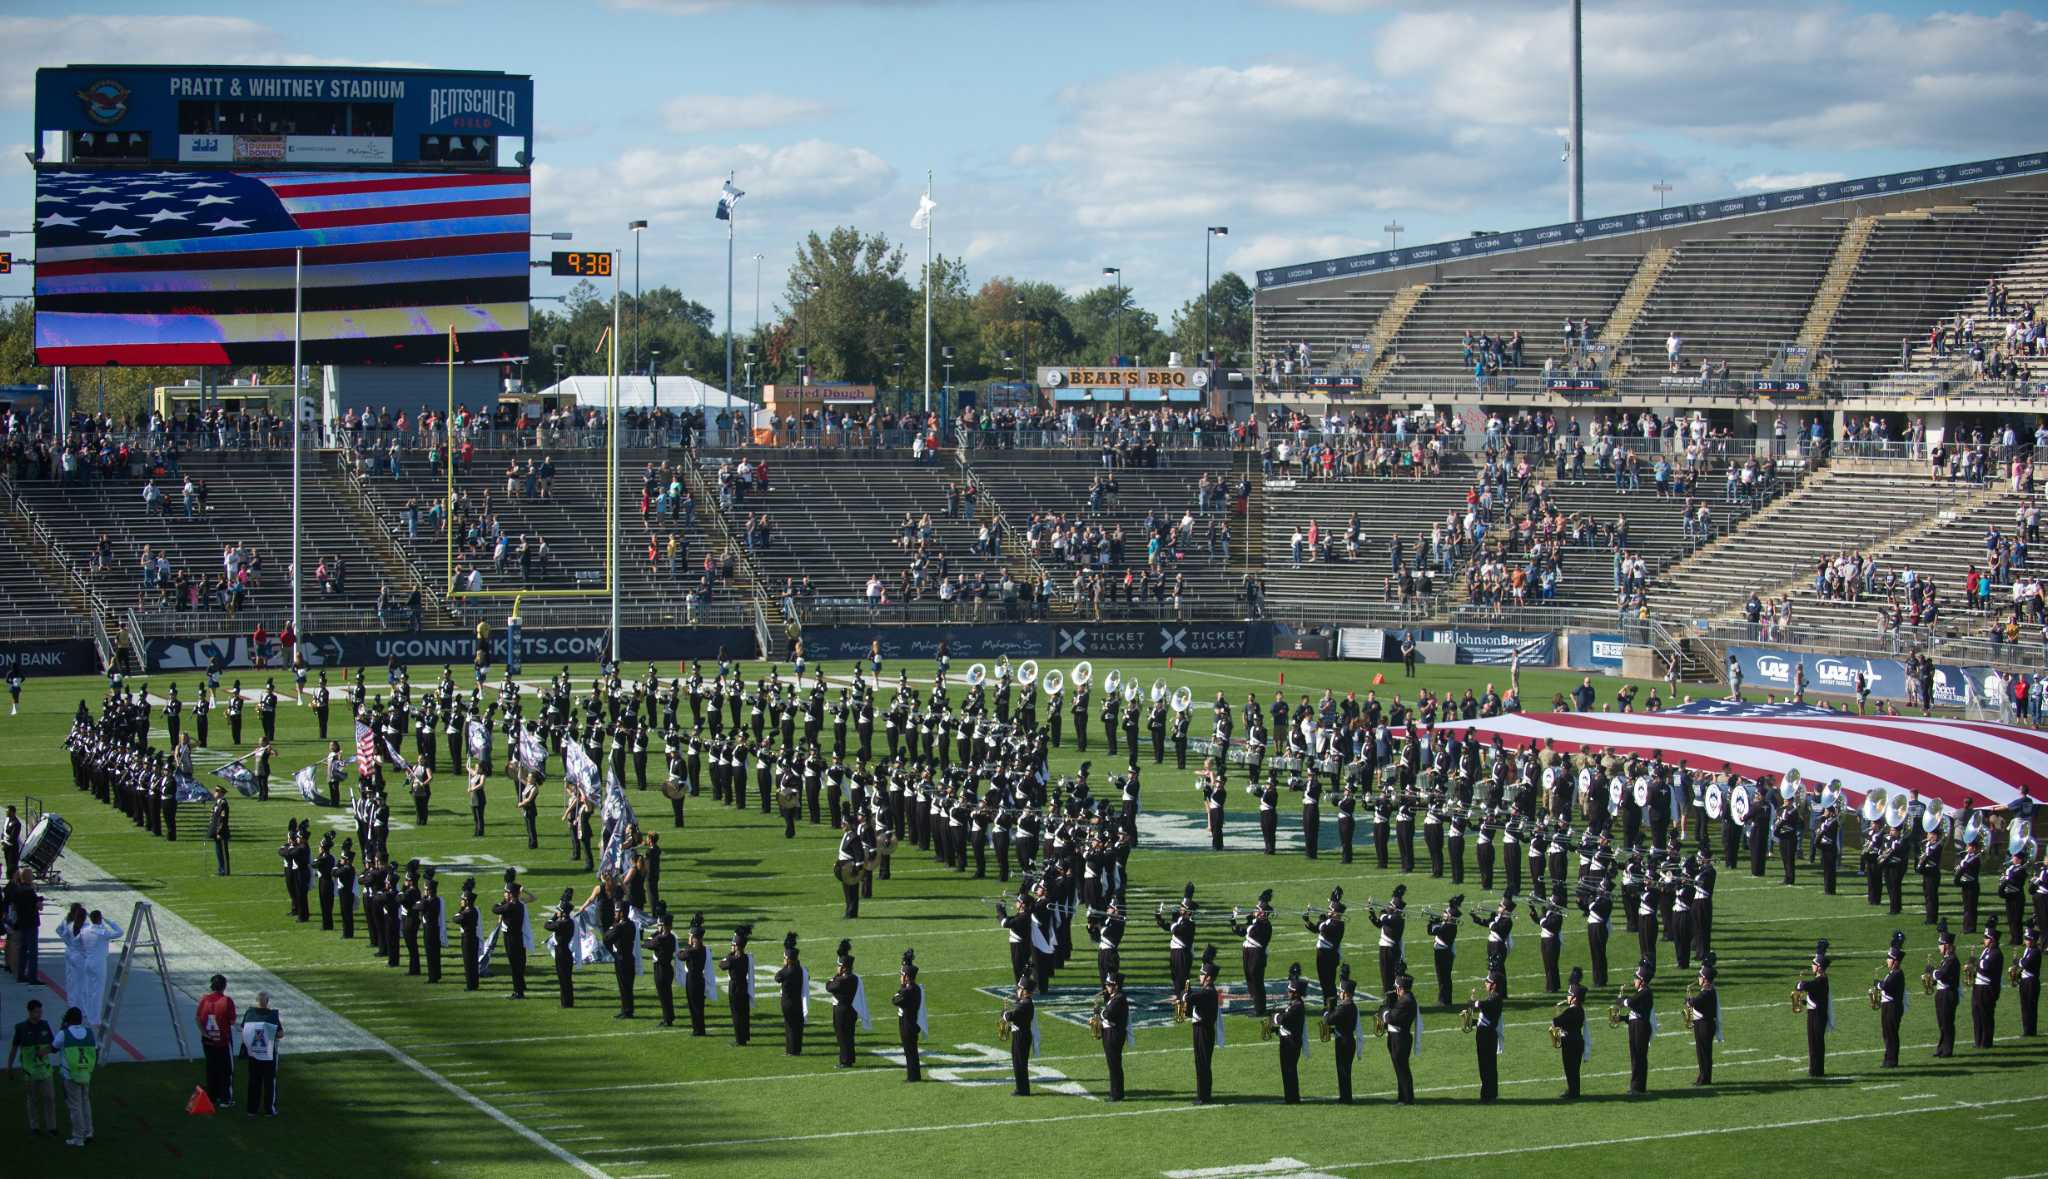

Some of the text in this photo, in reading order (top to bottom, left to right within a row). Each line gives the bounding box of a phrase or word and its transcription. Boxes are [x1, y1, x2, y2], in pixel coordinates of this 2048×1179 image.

[170, 77, 405, 99] PRATT & WHITNEY STADIUM
[430, 88, 515, 127] RENTSCHLER
[568, 253, 611, 275] 9:38
[1069, 371, 1139, 386] BEAR'S
[1147, 371, 1186, 387] BBQ
[1785, 382, 1800, 390] 230
[823, 388, 865, 400] Dough
[1090, 632, 1145, 642] TICKET
[1192, 630, 1245, 641] TICKET
[376, 637, 602, 657] UCONNTIKTS.COM
[1090, 642, 1144, 651] GALAXY
[1192, 641, 1245, 650] GALAXY
[21, 652, 62, 666] BANK
[1760, 661, 1789, 678] LAZ
[1819, 664, 1849, 681] LAZ
